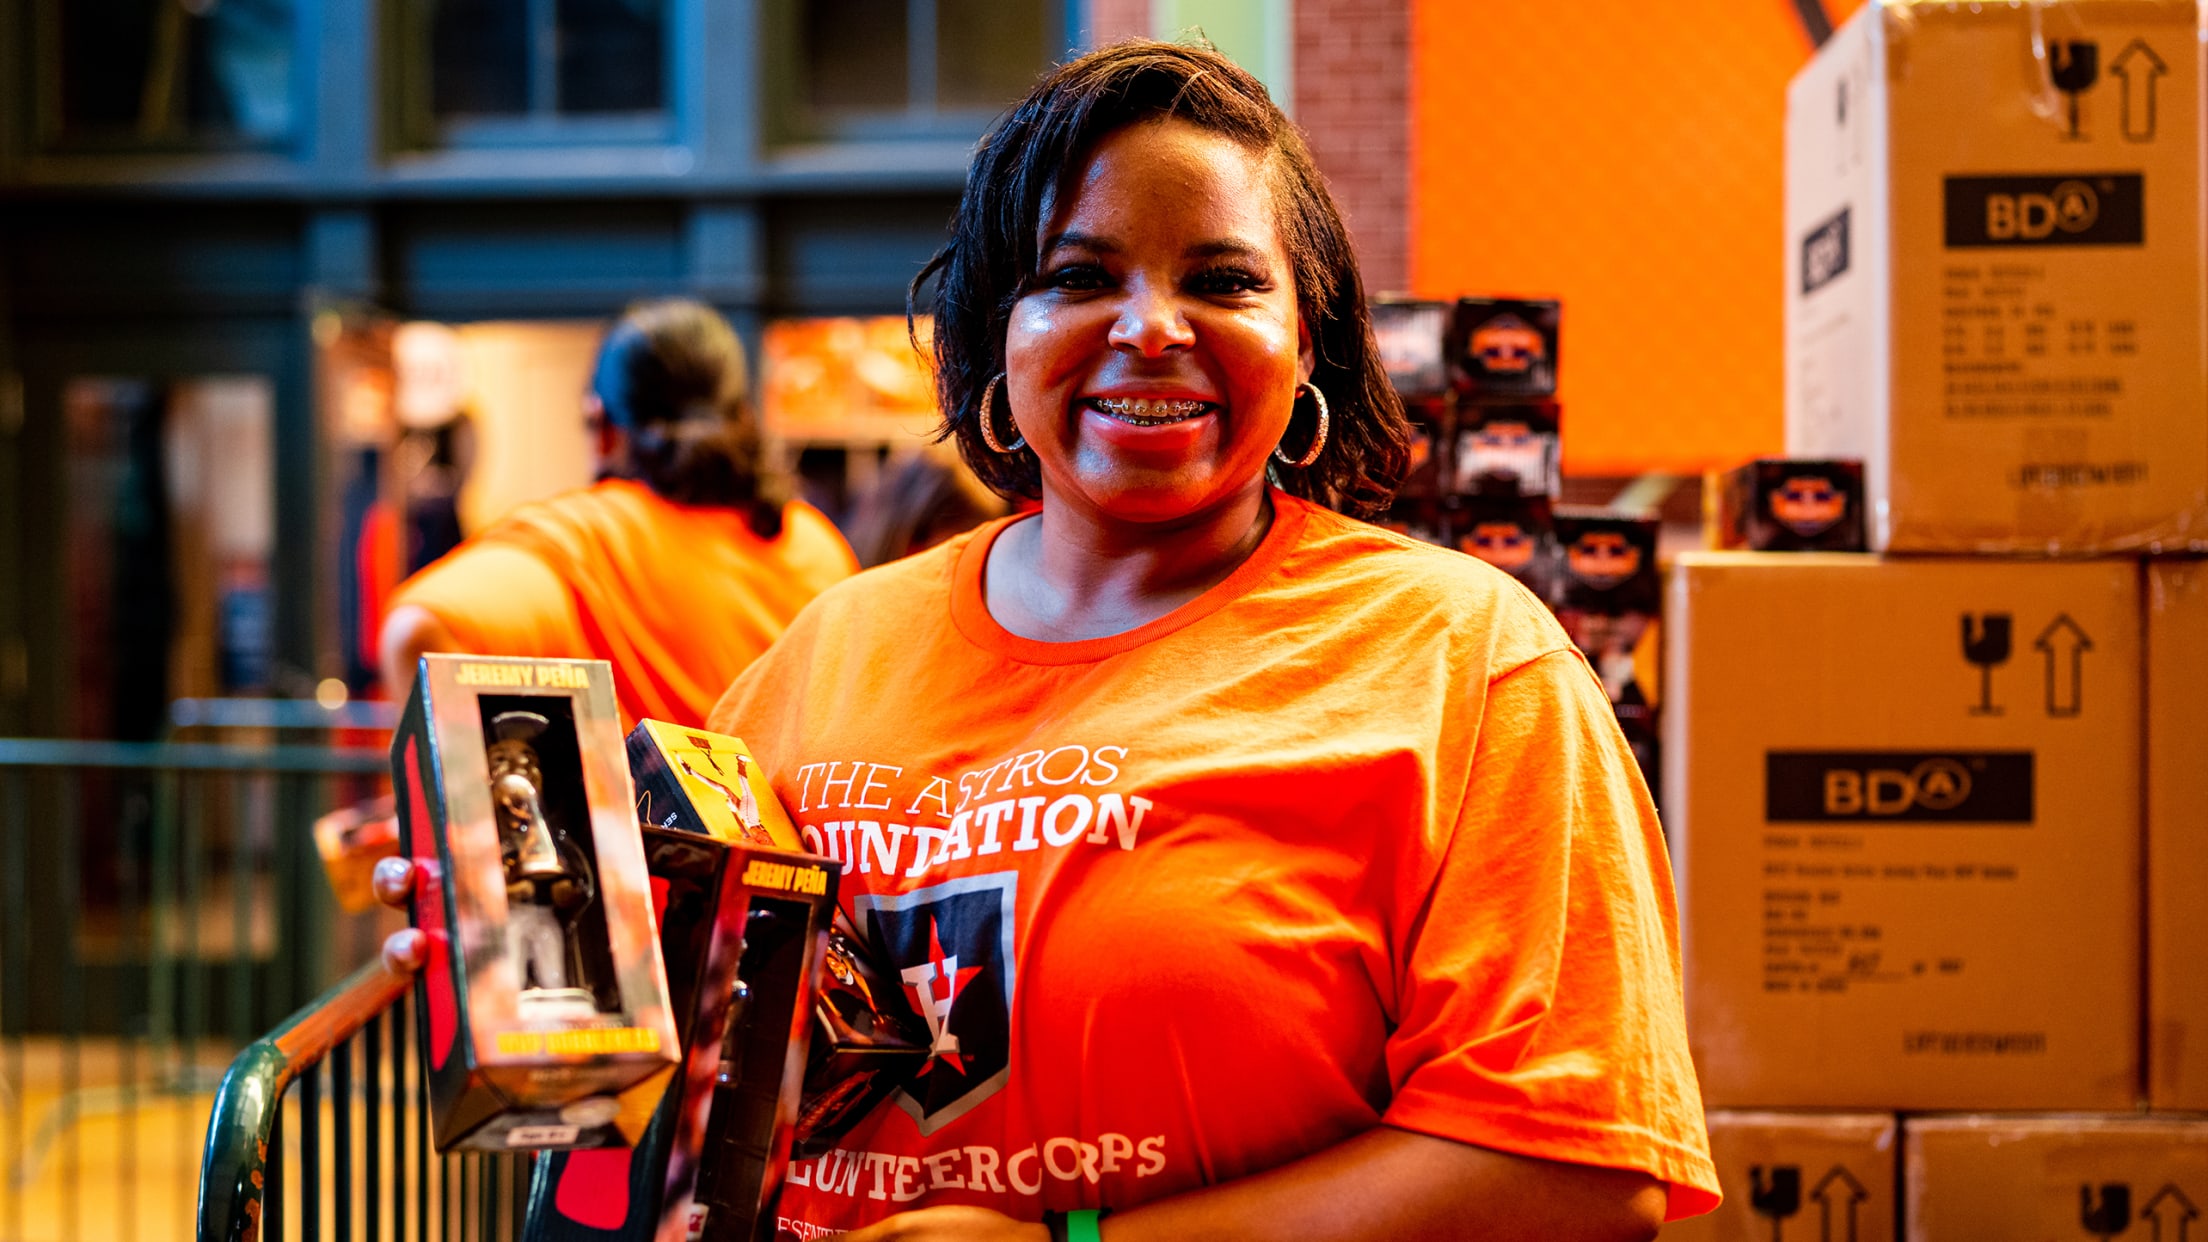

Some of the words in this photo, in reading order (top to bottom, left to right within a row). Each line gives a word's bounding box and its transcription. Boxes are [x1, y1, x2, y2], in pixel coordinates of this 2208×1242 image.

[455, 662, 533, 686] JEREMY
[535, 663, 590, 688] PEÑA
[796, 761, 902, 813] THE
[905, 745, 1128, 818] ASTROS
[801, 793, 1153, 877] OUNDATION
[742, 860, 796, 891] JEREMY
[793, 865, 827, 896] PEÑA
